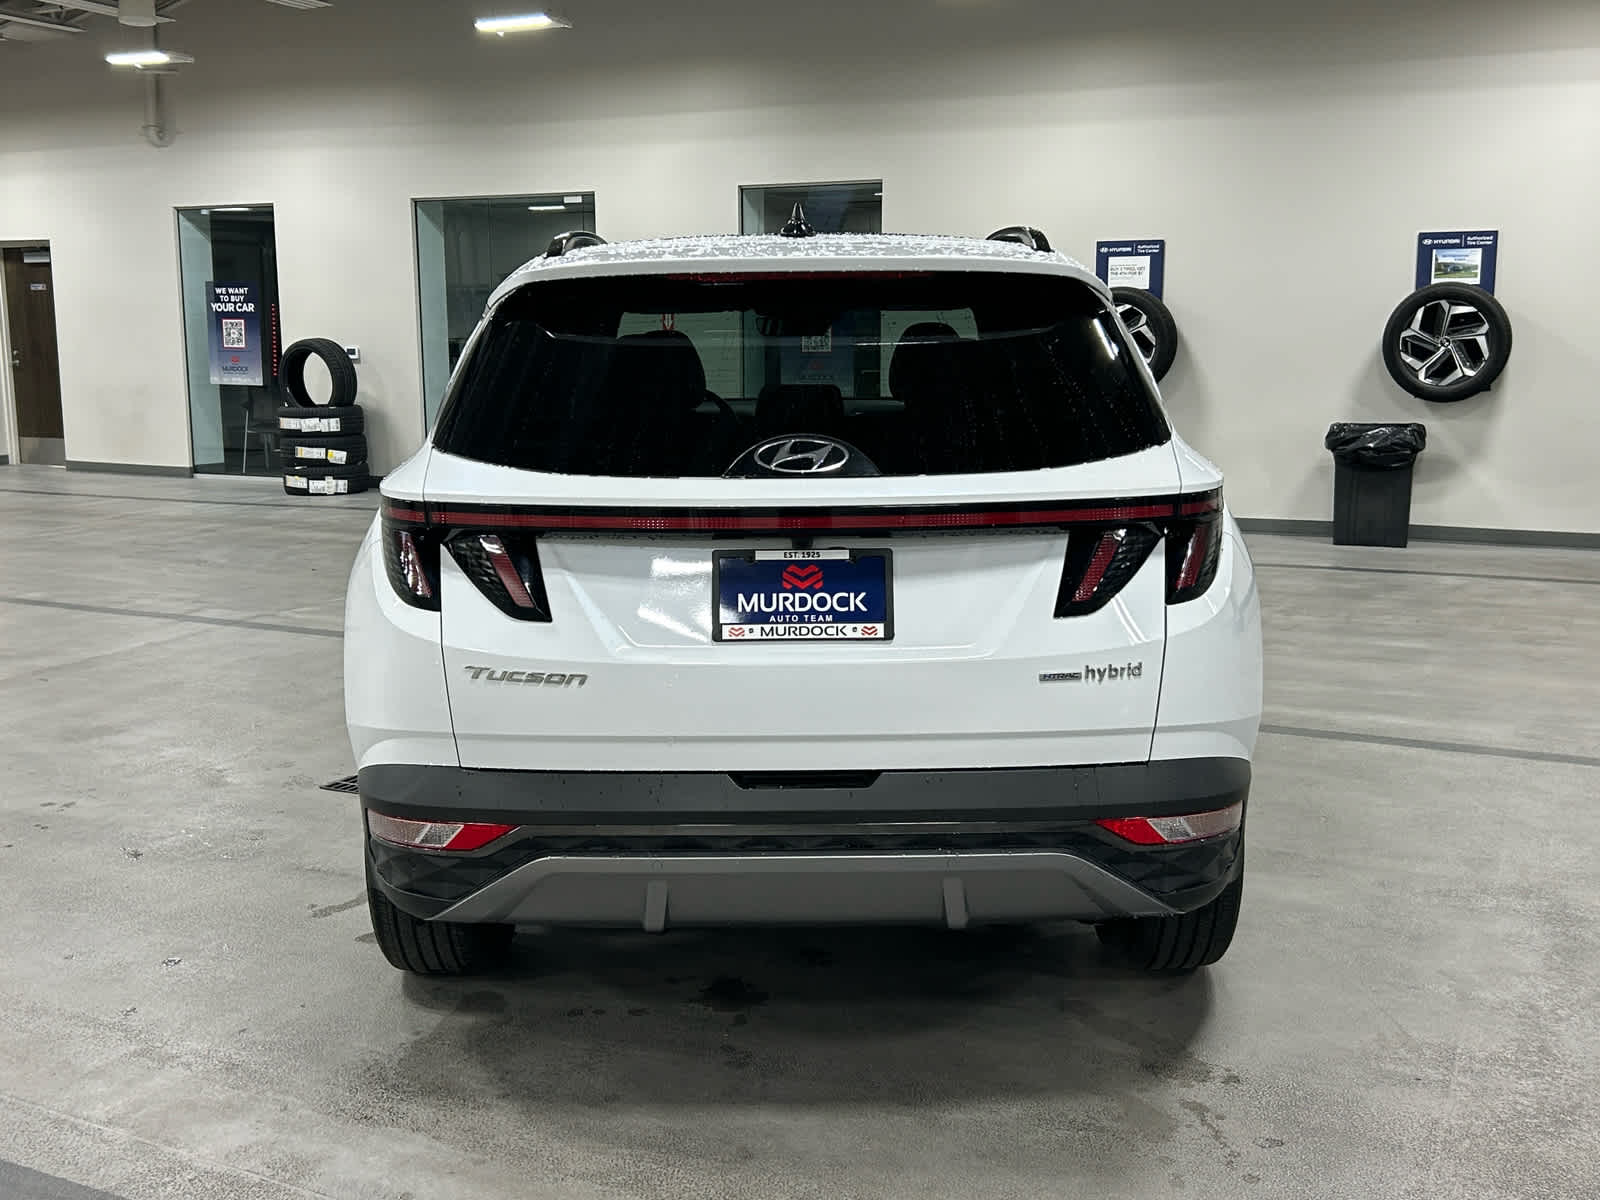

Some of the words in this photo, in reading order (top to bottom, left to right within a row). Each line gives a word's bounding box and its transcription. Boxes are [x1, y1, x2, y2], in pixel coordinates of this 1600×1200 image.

[215, 287, 226, 295] WE
[228, 287, 249, 295] WANT
[211, 303, 234, 312] YOUR
[236, 303, 255, 312] CAR
[801, 551, 821, 559] 1925
[737, 592, 868, 613] MURDOCK
[769, 615, 799, 623] AUTO
[804, 614, 833, 622] TEAM
[760, 625, 848, 637] MURDOCK
[1084, 661, 1143, 686] hybrid
